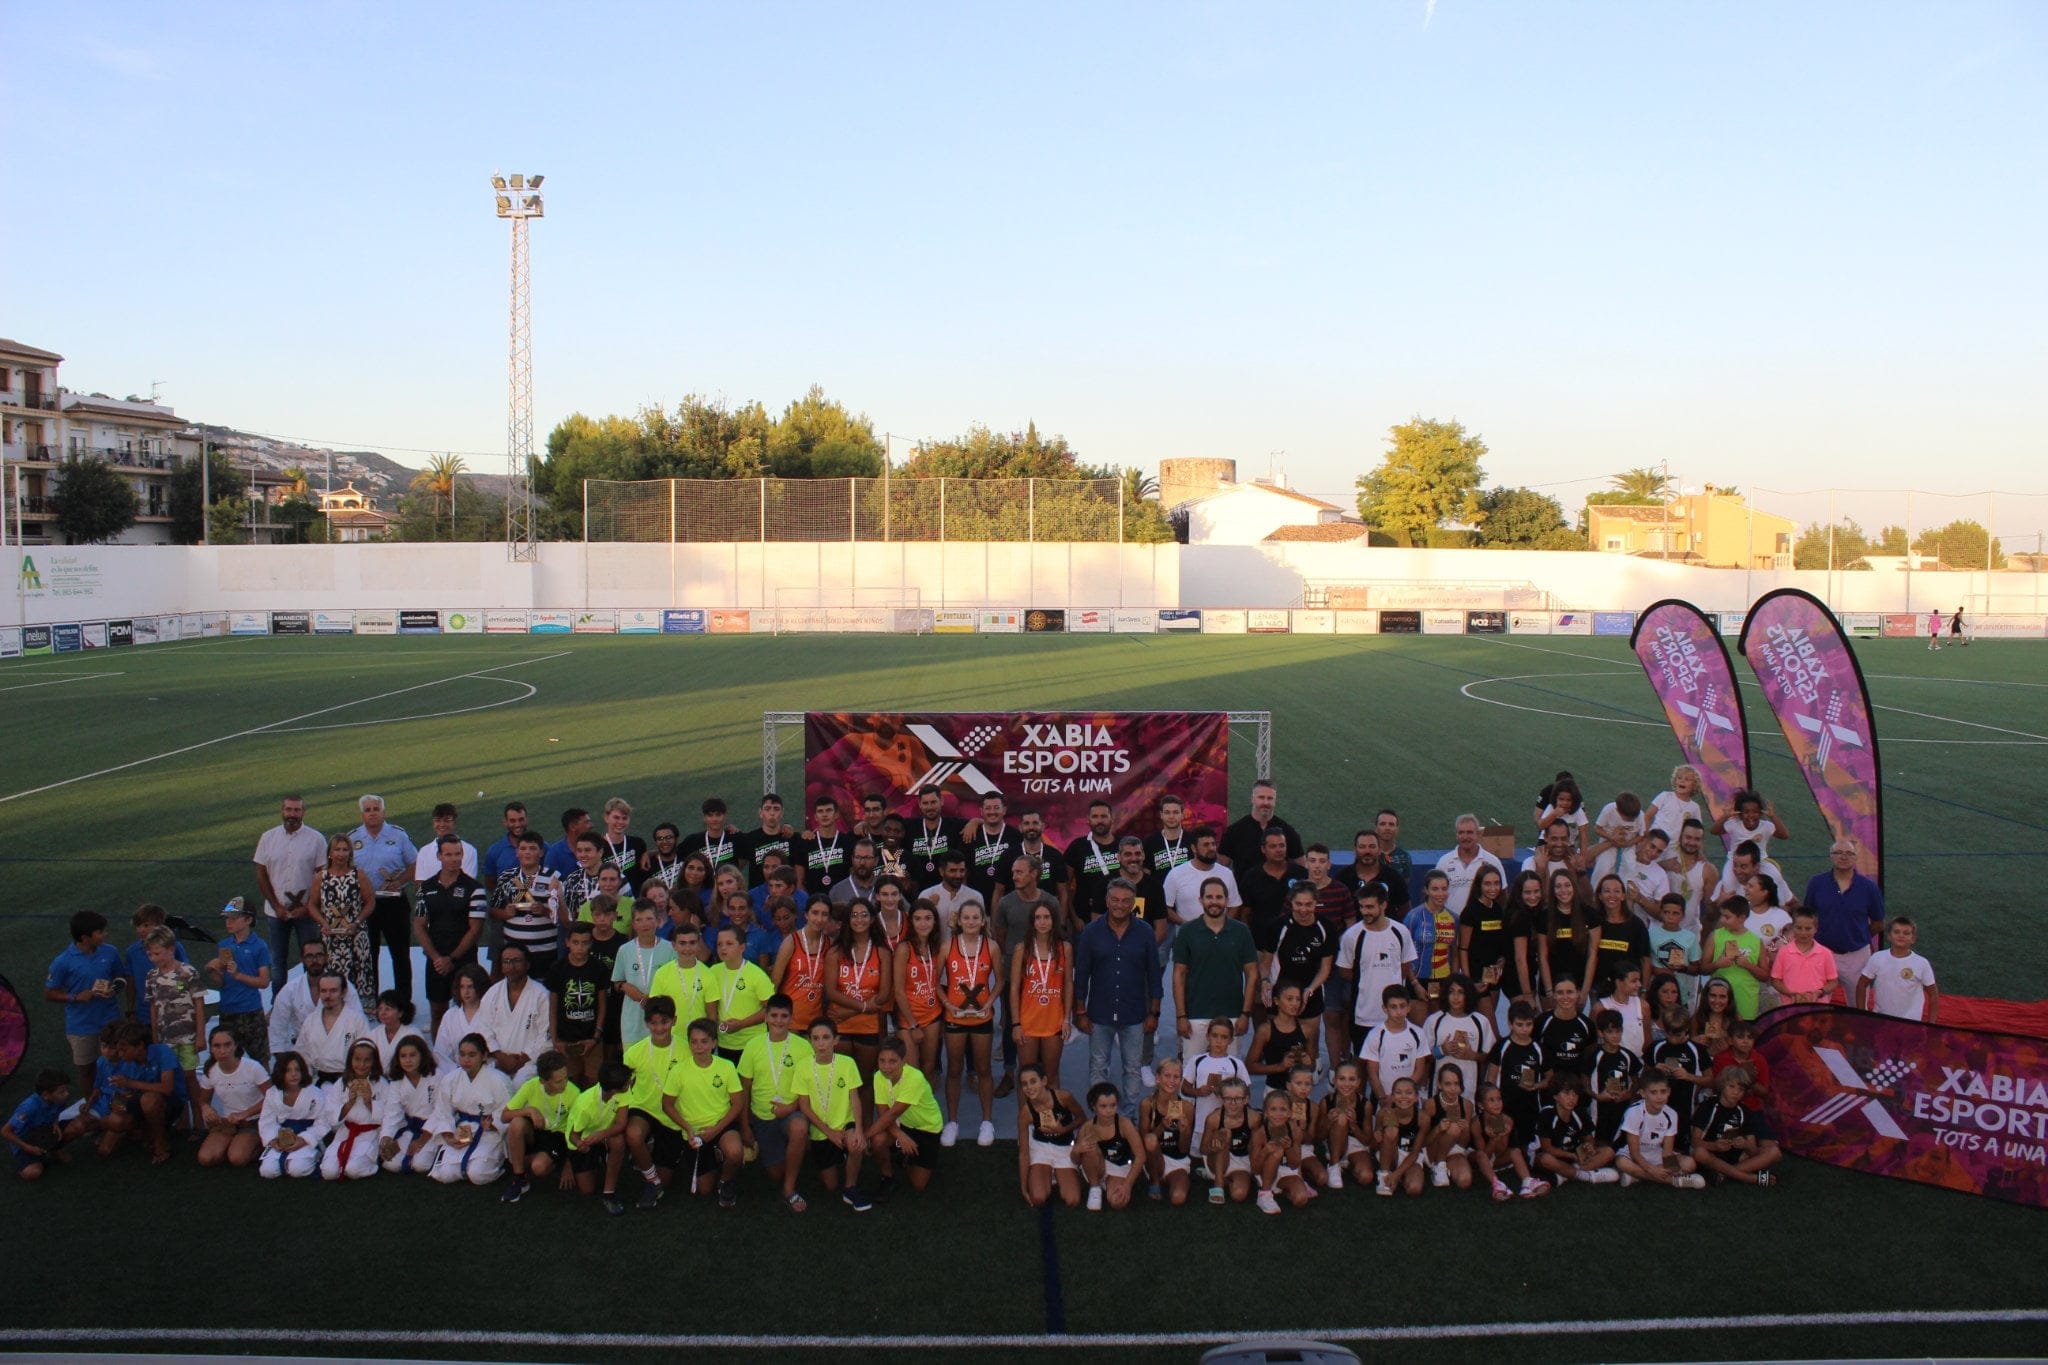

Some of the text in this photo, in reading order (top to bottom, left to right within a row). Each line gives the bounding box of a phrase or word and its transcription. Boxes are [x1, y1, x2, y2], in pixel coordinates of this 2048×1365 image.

[1003, 750, 1131, 773] ESPORTS
[1021, 778, 1112, 795] TOTS A UNA
[797, 958, 802, 971] 1
[840, 965, 849, 978] 19
[952, 960, 958, 973] 9
[911, 966, 918, 979] 8
[1914, 1092, 2048, 1139] ESPORT
[1932, 1127, 2046, 1167] TOTS A UNA
